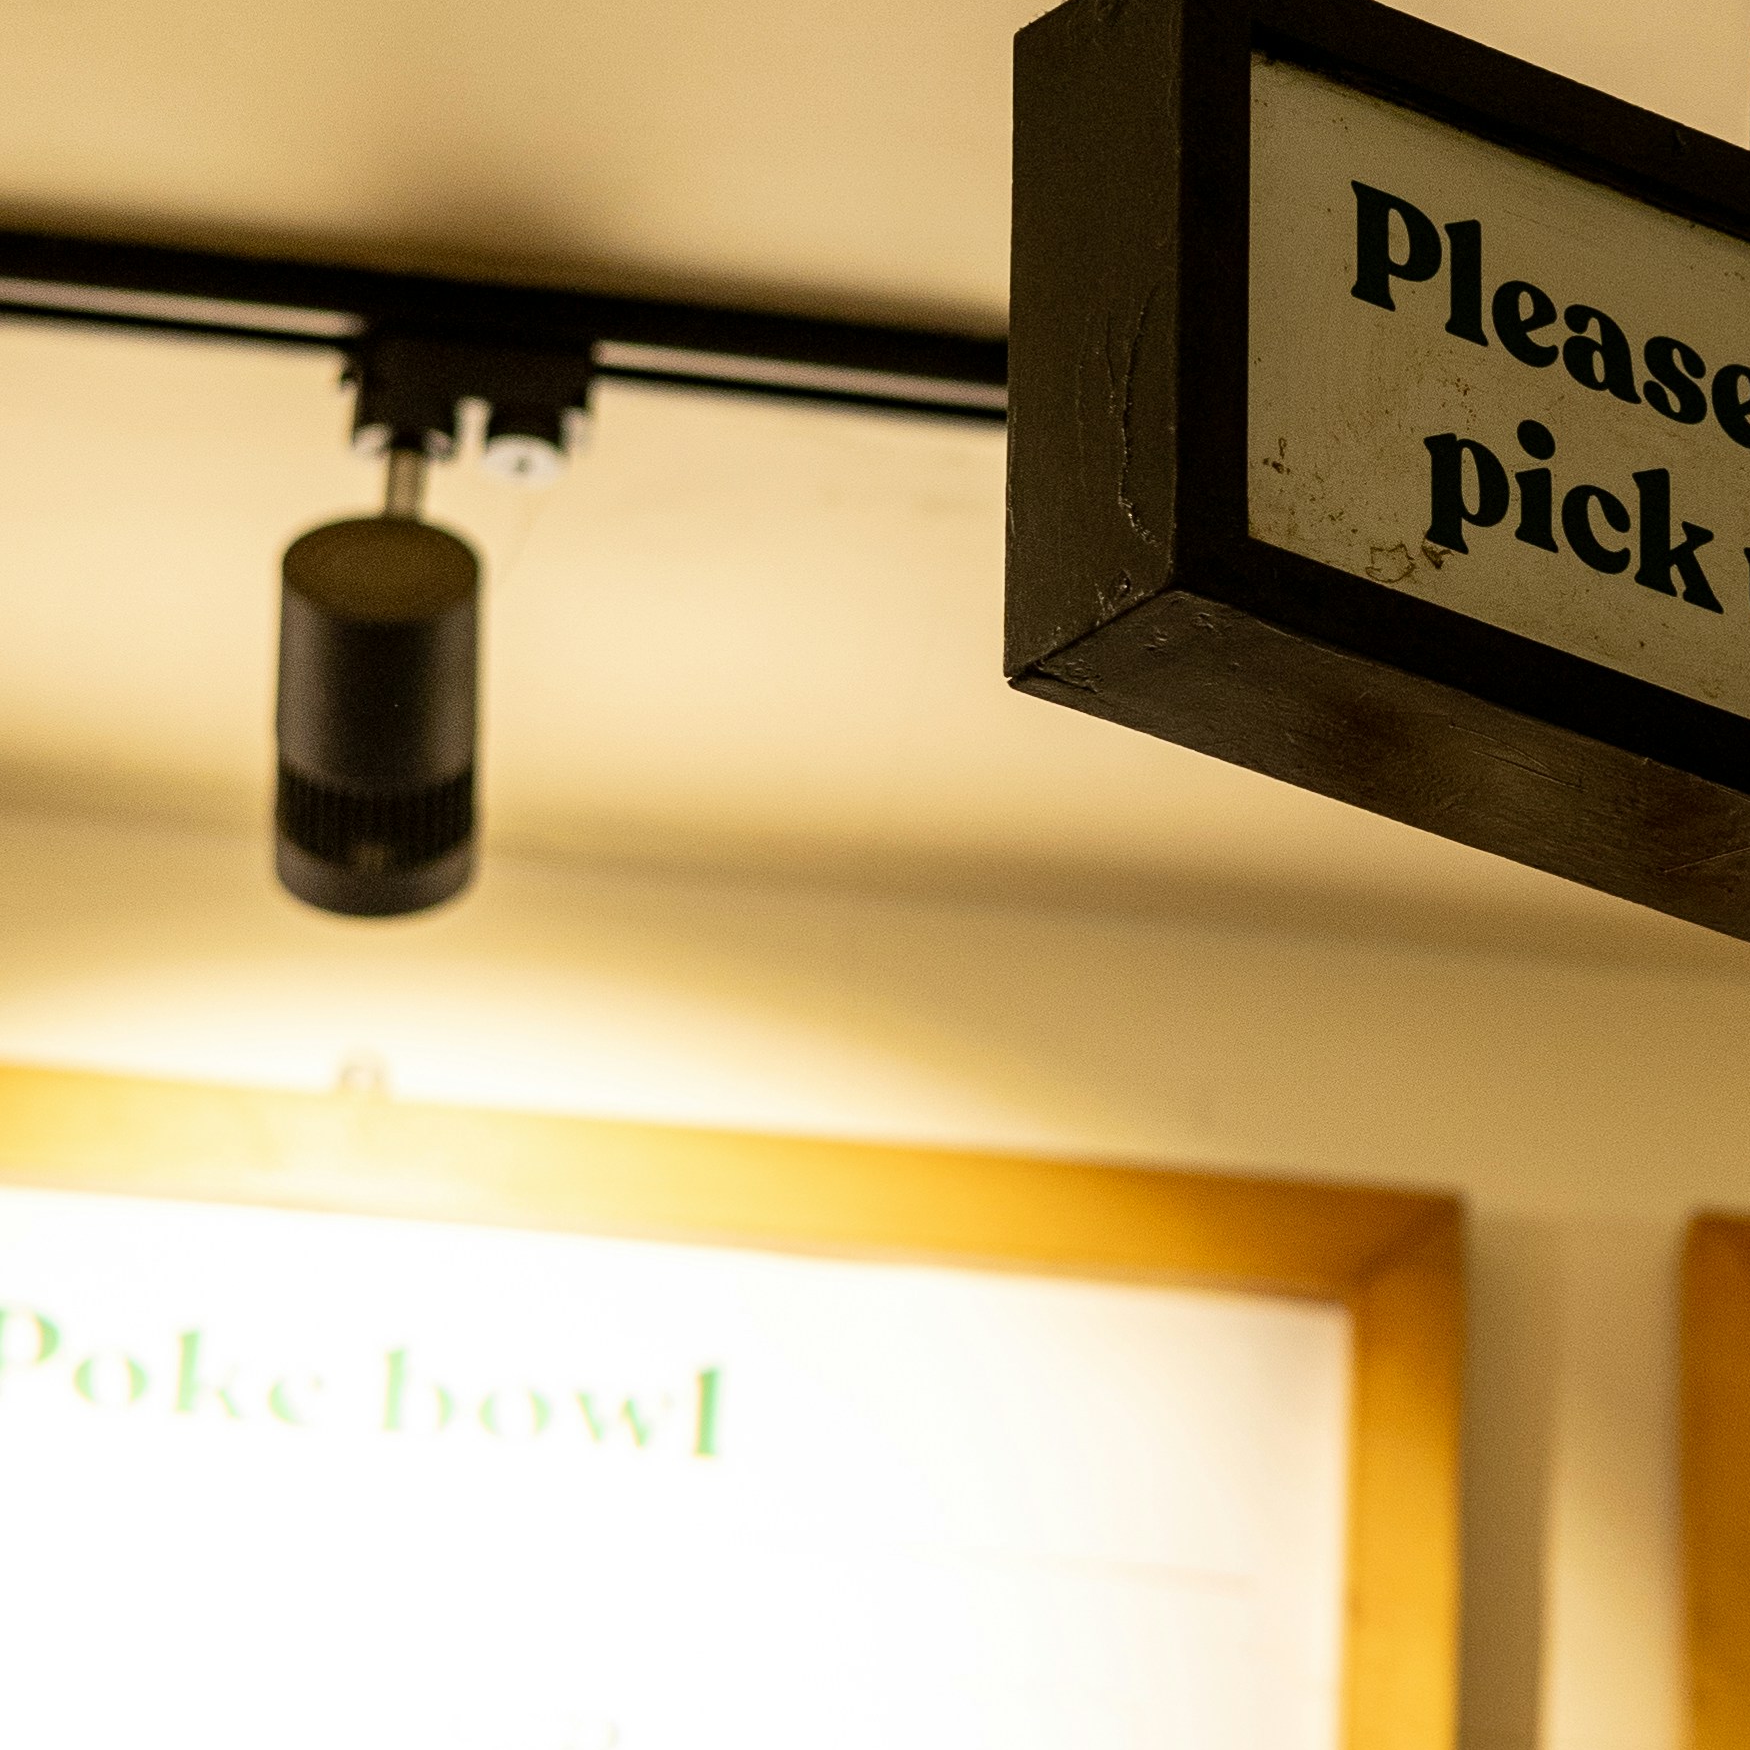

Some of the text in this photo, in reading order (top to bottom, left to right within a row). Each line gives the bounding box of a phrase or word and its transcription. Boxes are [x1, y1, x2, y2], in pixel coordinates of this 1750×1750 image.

[1423, 419, 1723, 614] pick
[0, 1303, 722, 1460] Poke bowl
